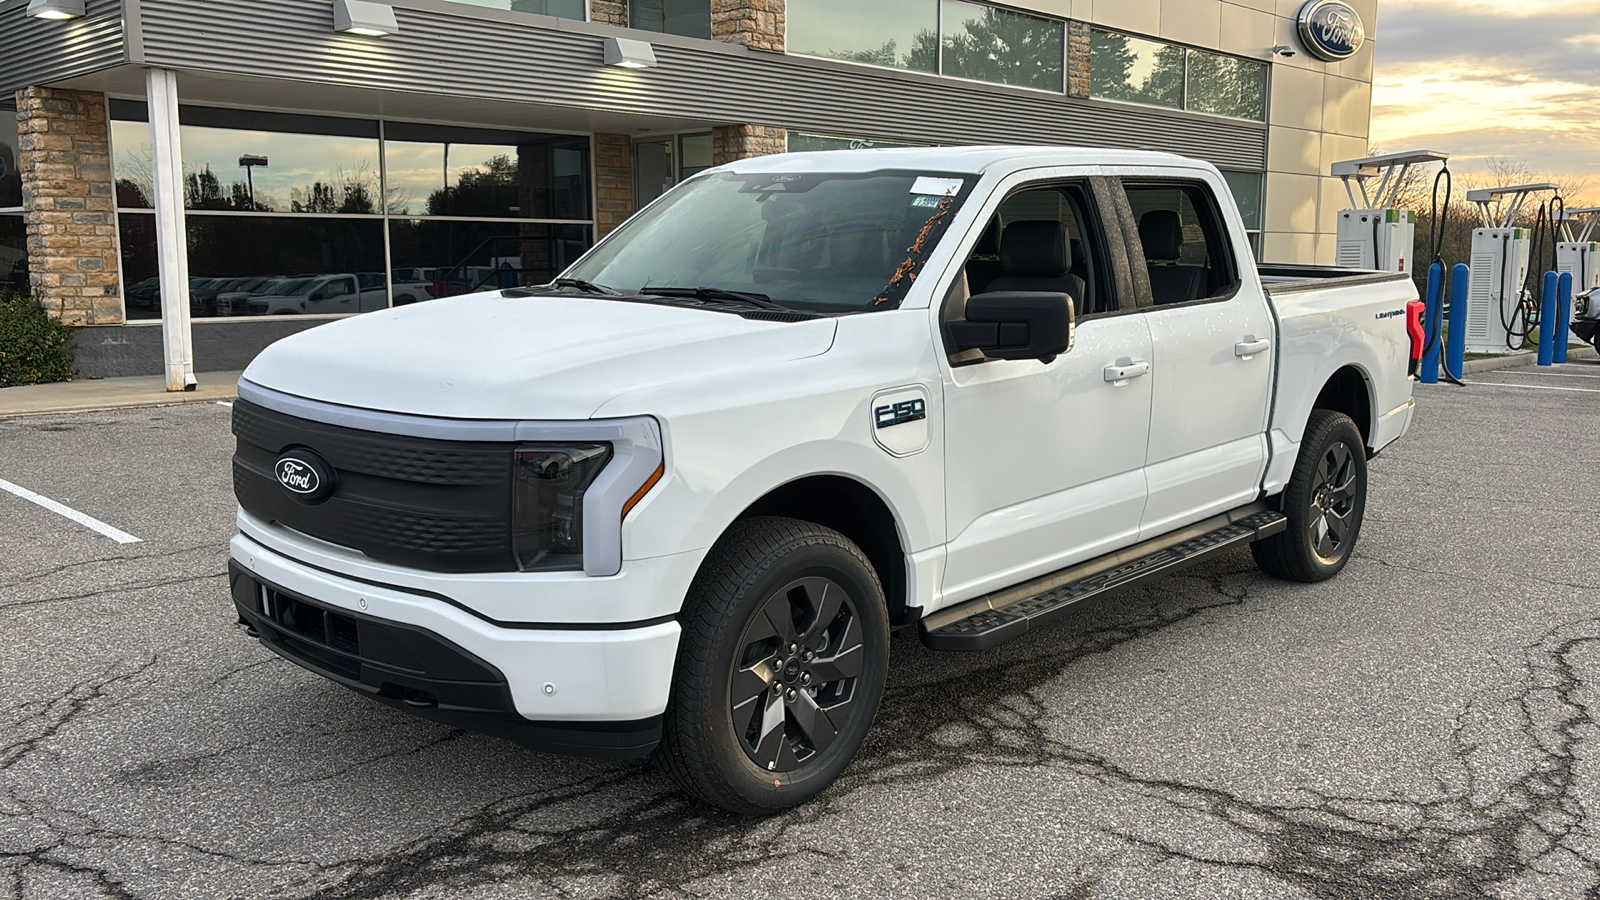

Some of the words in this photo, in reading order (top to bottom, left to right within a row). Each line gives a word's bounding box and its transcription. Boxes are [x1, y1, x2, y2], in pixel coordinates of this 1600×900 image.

[1322, 11, 1358, 47] Ford
[875, 398, 926, 424] F-150
[281, 461, 311, 489] Ford
